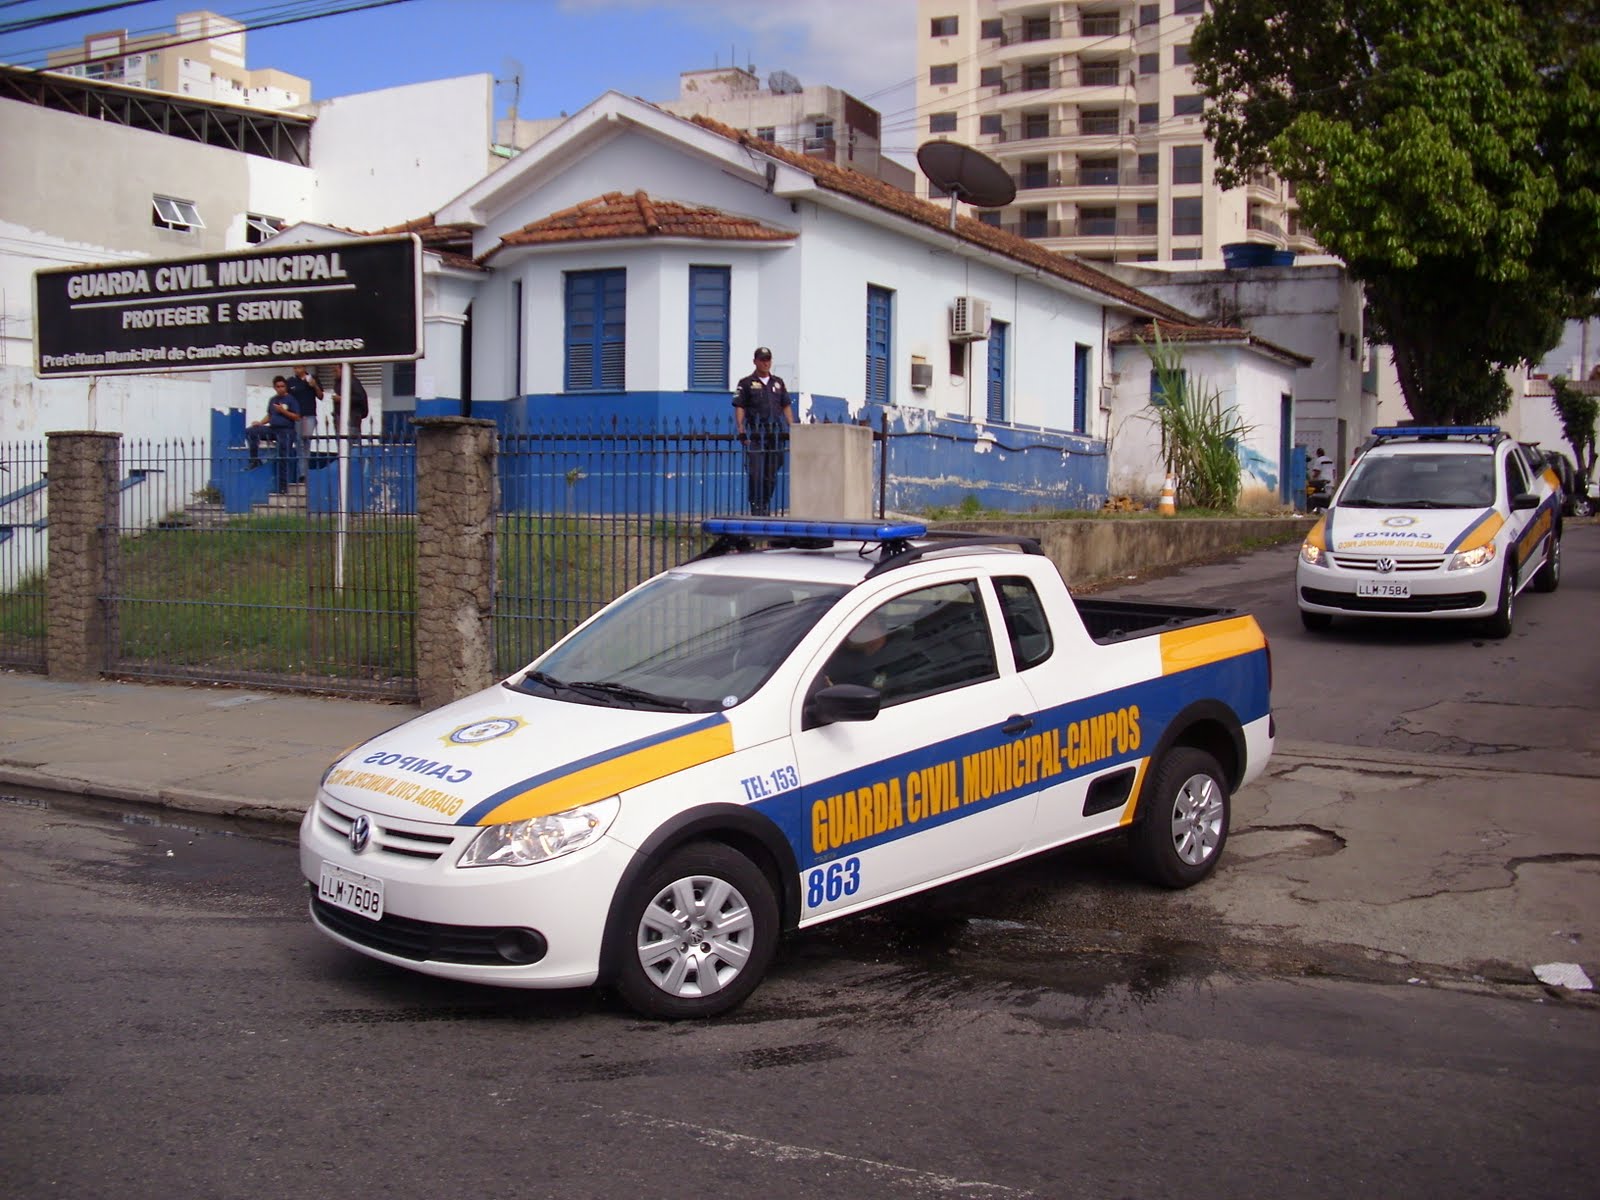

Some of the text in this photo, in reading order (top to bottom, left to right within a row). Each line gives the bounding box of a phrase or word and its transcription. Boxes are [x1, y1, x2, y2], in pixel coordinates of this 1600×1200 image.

[67, 252, 347, 299] GUARDA CIVIL MUNICIPAL
[122, 300, 303, 330] PROTEGER E SERVIR
[42, 338, 365, 368] Prefeitura Municipal de Campos dos Goytacazes
[740, 765, 798, 801] TEL: 153
[811, 777, 901, 855] GUARDA
[906, 762, 959, 824] CIVIL
[807, 856, 861, 909] 863
